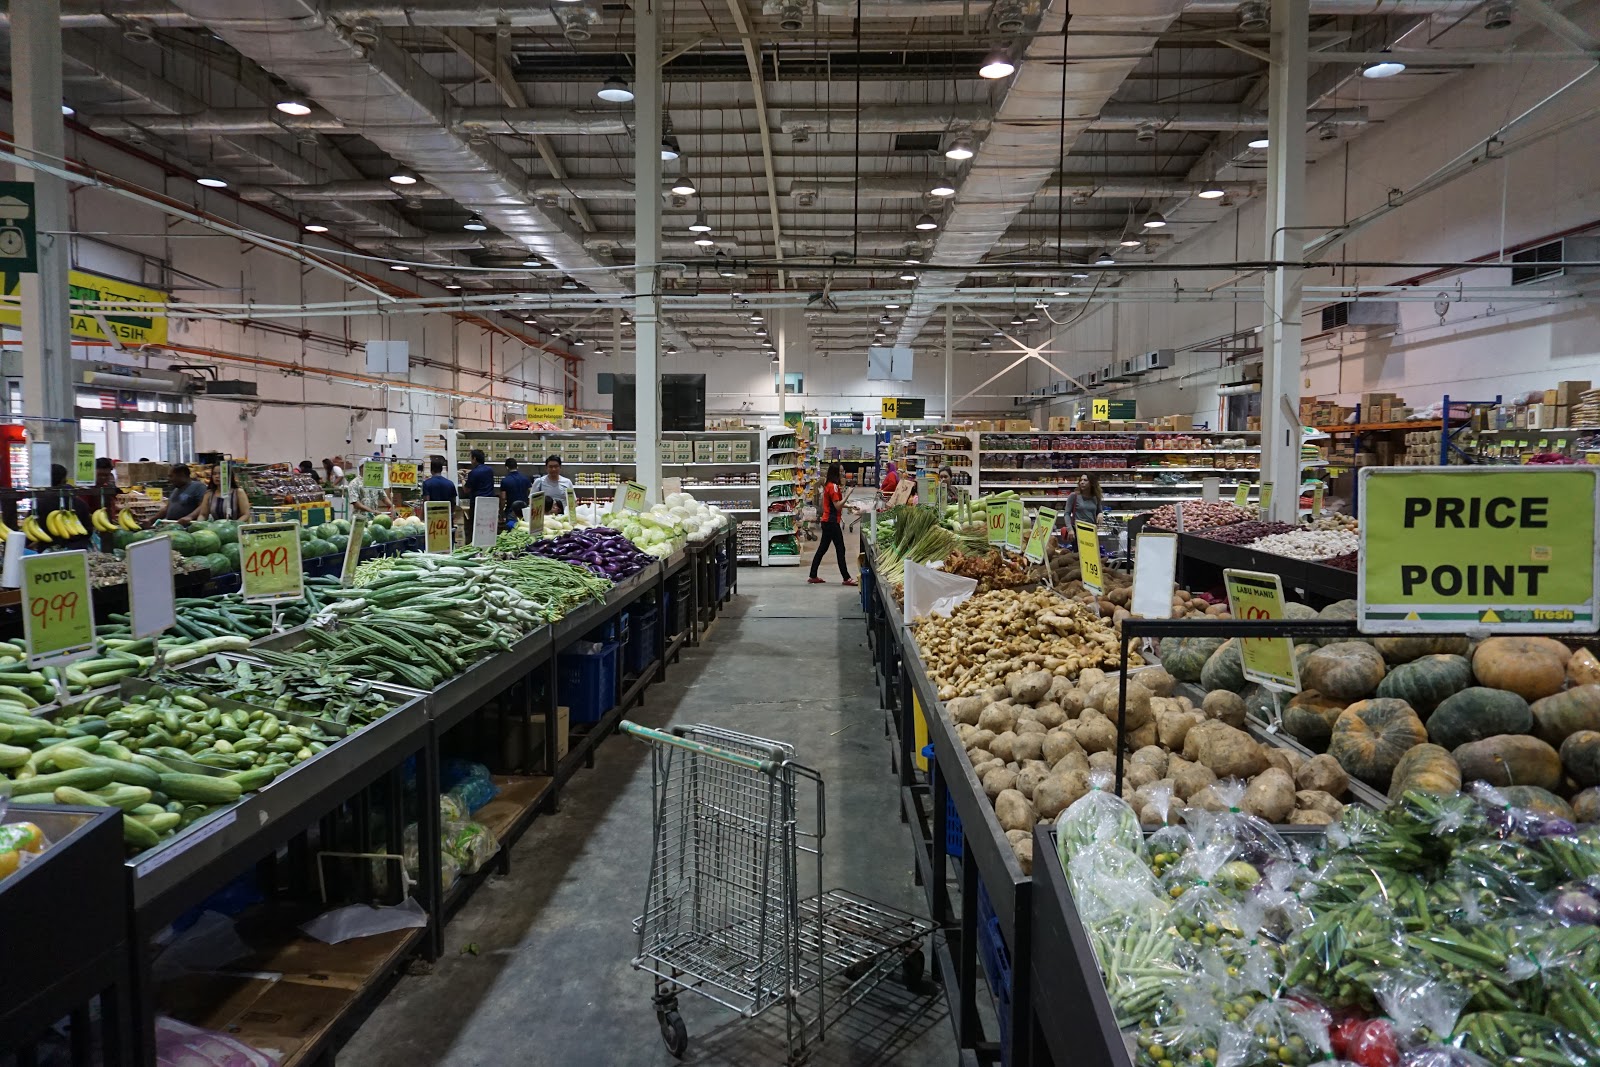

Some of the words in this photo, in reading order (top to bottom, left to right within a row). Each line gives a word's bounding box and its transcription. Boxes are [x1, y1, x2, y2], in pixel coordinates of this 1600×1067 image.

[882, 402, 896, 413] 14
[1093, 404, 1107, 415] 14
[1403, 497, 1549, 529] PRICE
[428, 519, 448, 540] 4.99
[245, 546, 289, 577] 4.99
[34, 569, 76, 585] POTOL
[1401, 564, 1549, 597] POINT
[1236, 585, 1253, 595] LABU
[1253, 588, 1275, 599] MANIS
[31, 591, 79, 629] 9.99
[1533, 608, 1574, 620] fresh
